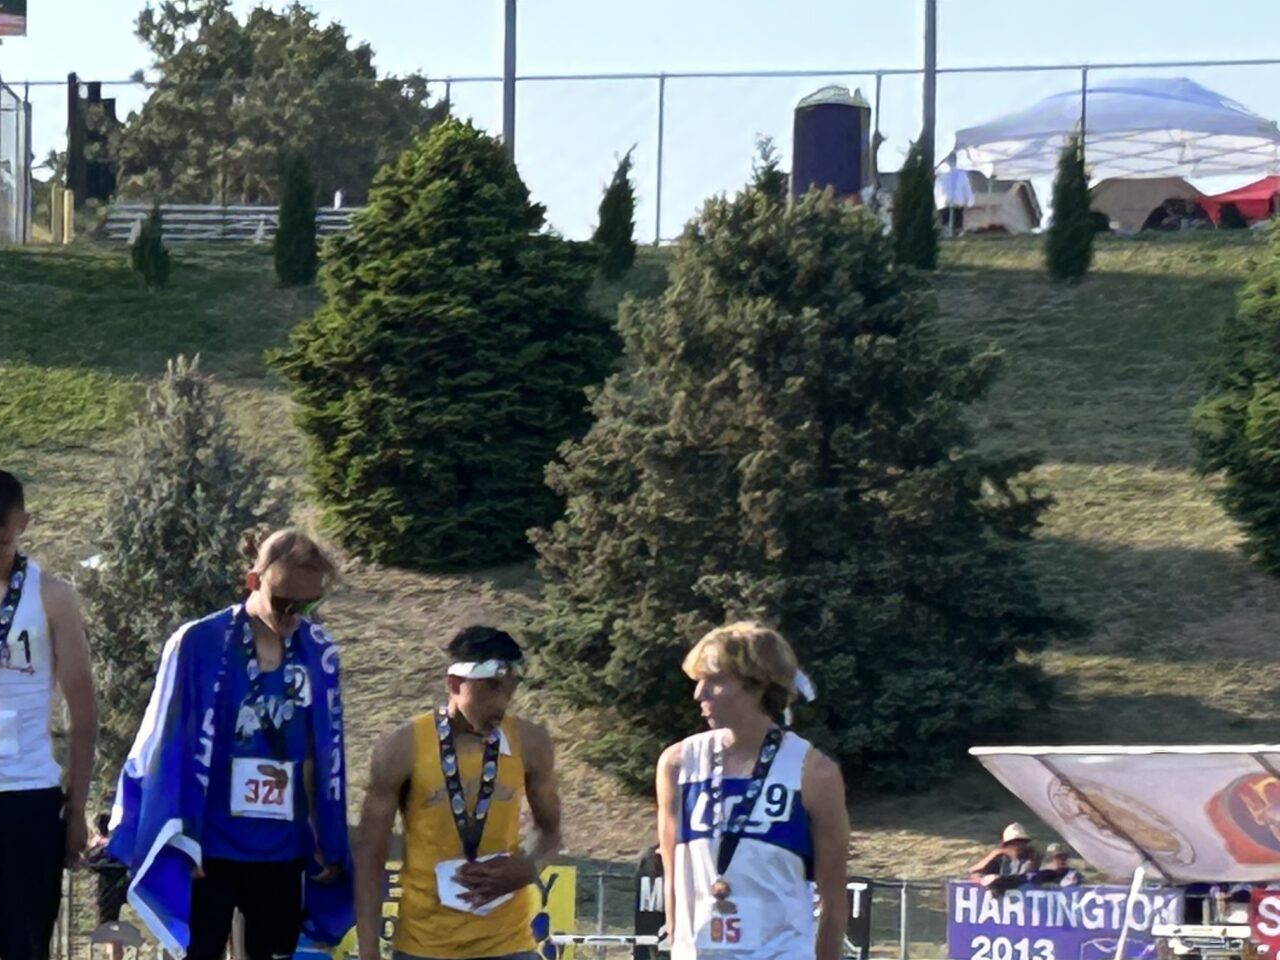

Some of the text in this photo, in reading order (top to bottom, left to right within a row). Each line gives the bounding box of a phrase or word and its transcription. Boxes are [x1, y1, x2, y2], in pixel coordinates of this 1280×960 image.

[17, 629, 31, 663] 1
[765, 783, 788, 817] 9
[955, 886, 1178, 931] HARTINGTON
